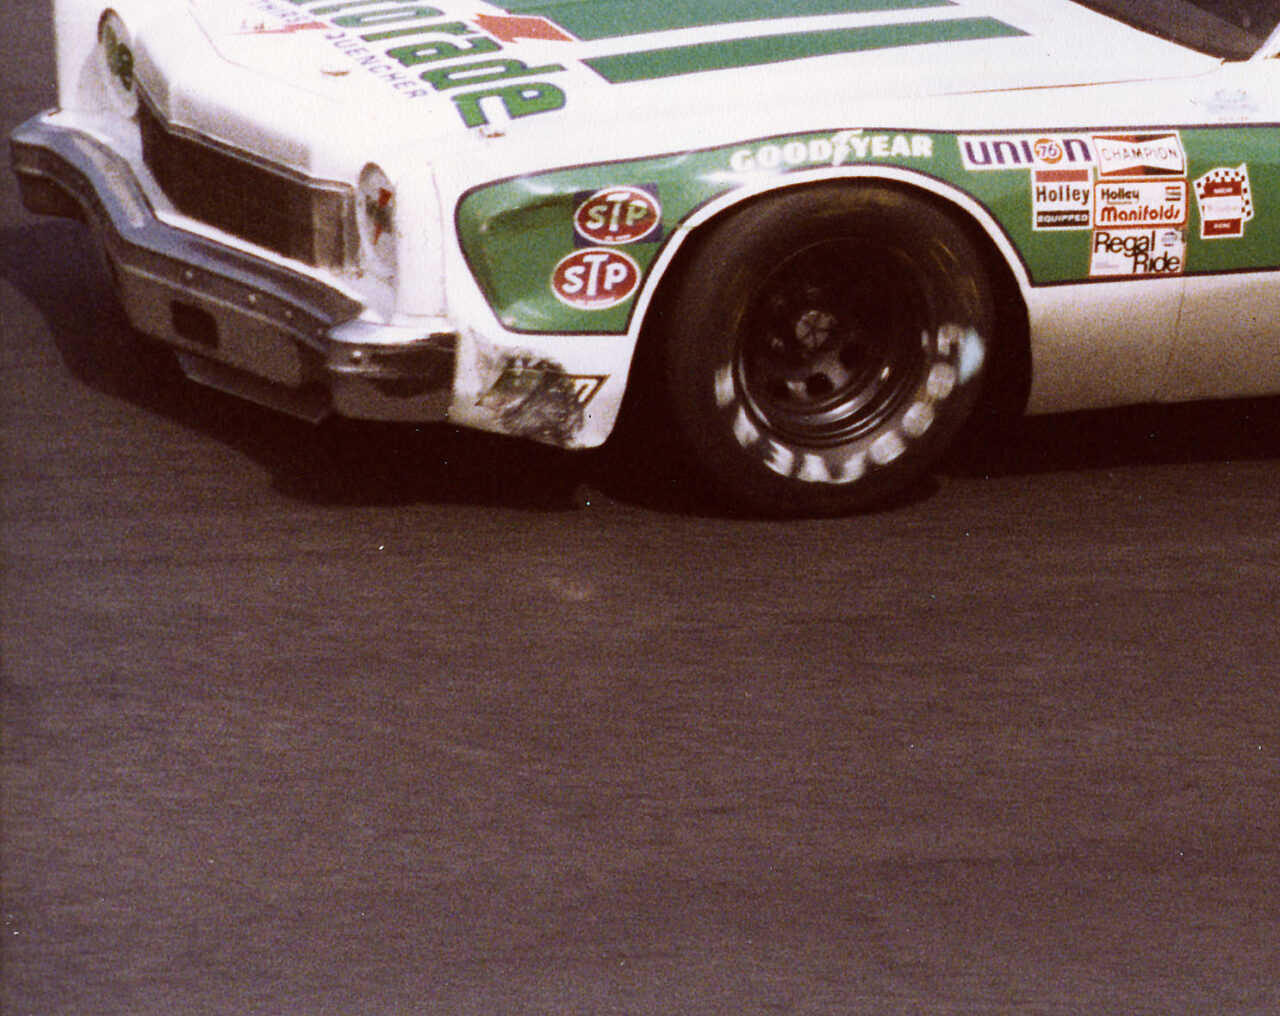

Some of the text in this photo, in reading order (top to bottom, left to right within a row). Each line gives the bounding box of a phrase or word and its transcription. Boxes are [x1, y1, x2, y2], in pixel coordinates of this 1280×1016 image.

[730, 134, 933, 172] GOODYEAR
[1101, 147, 1179, 161] CHAMPION
[1036, 184, 1090, 206] Holley
[1101, 188, 1140, 202] Holley
[585, 192, 648, 232] STP
[1038, 213, 1089, 224] EQUIPPED
[1101, 204, 1181, 222] Manifolds
[1094, 230, 1156, 258] Regal
[1133, 251, 1181, 274] Ride
[562, 253, 628, 296] STP
